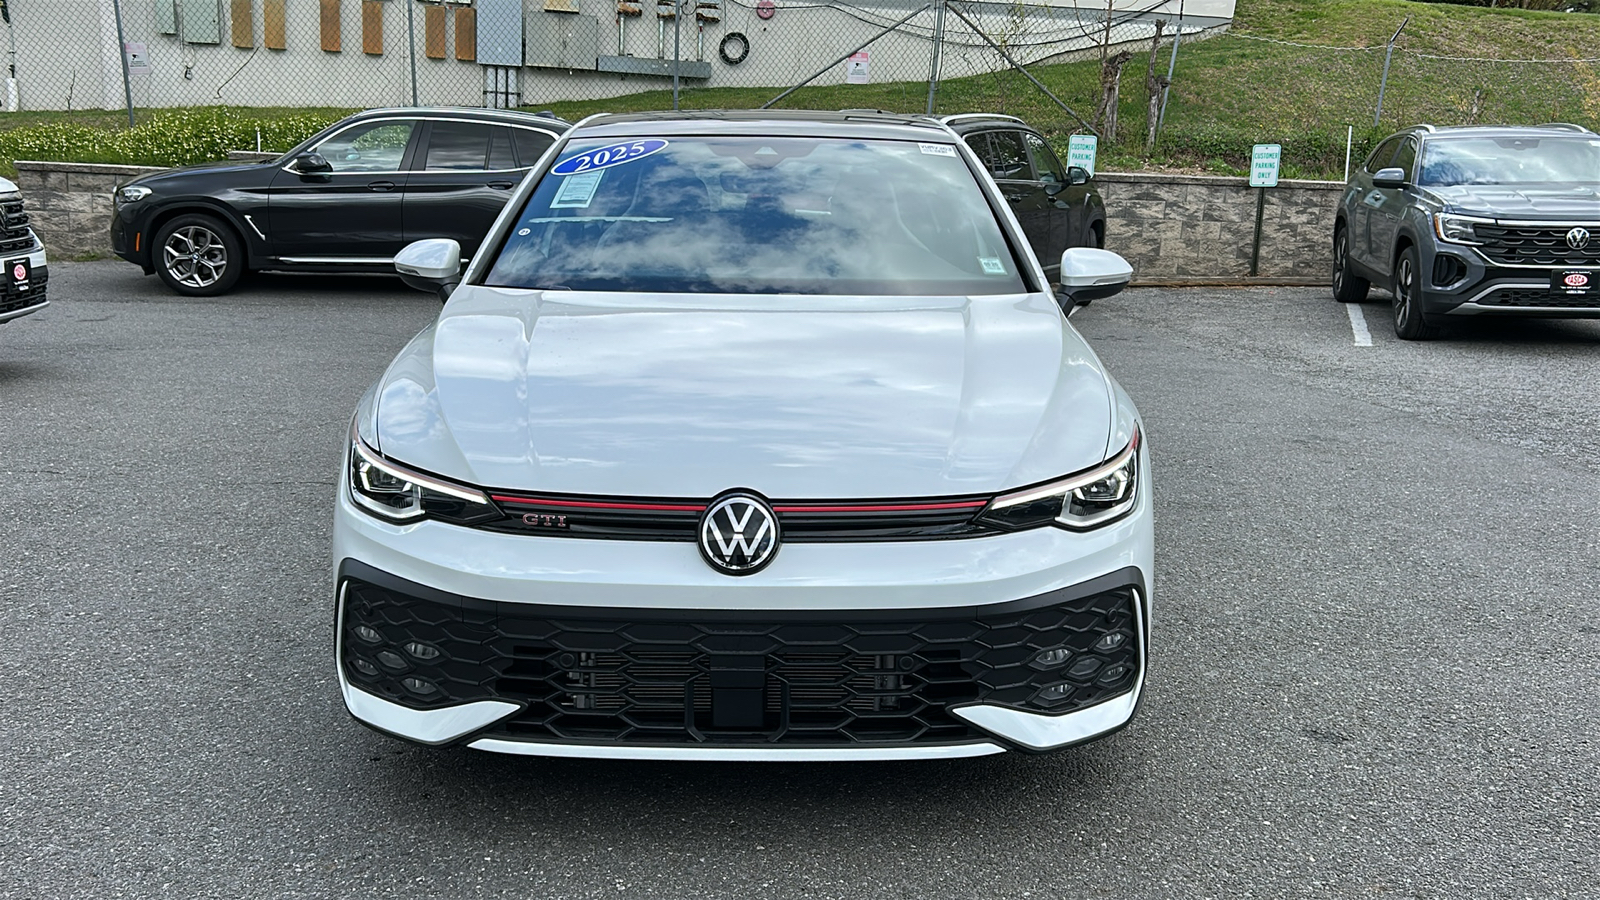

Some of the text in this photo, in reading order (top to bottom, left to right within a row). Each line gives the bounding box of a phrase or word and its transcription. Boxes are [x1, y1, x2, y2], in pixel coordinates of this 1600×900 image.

[574, 141, 645, 172] 2025
[1567, 275, 1585, 284] TASCA
[522, 513, 567, 527] GTI
[706, 499, 774, 566] VW
